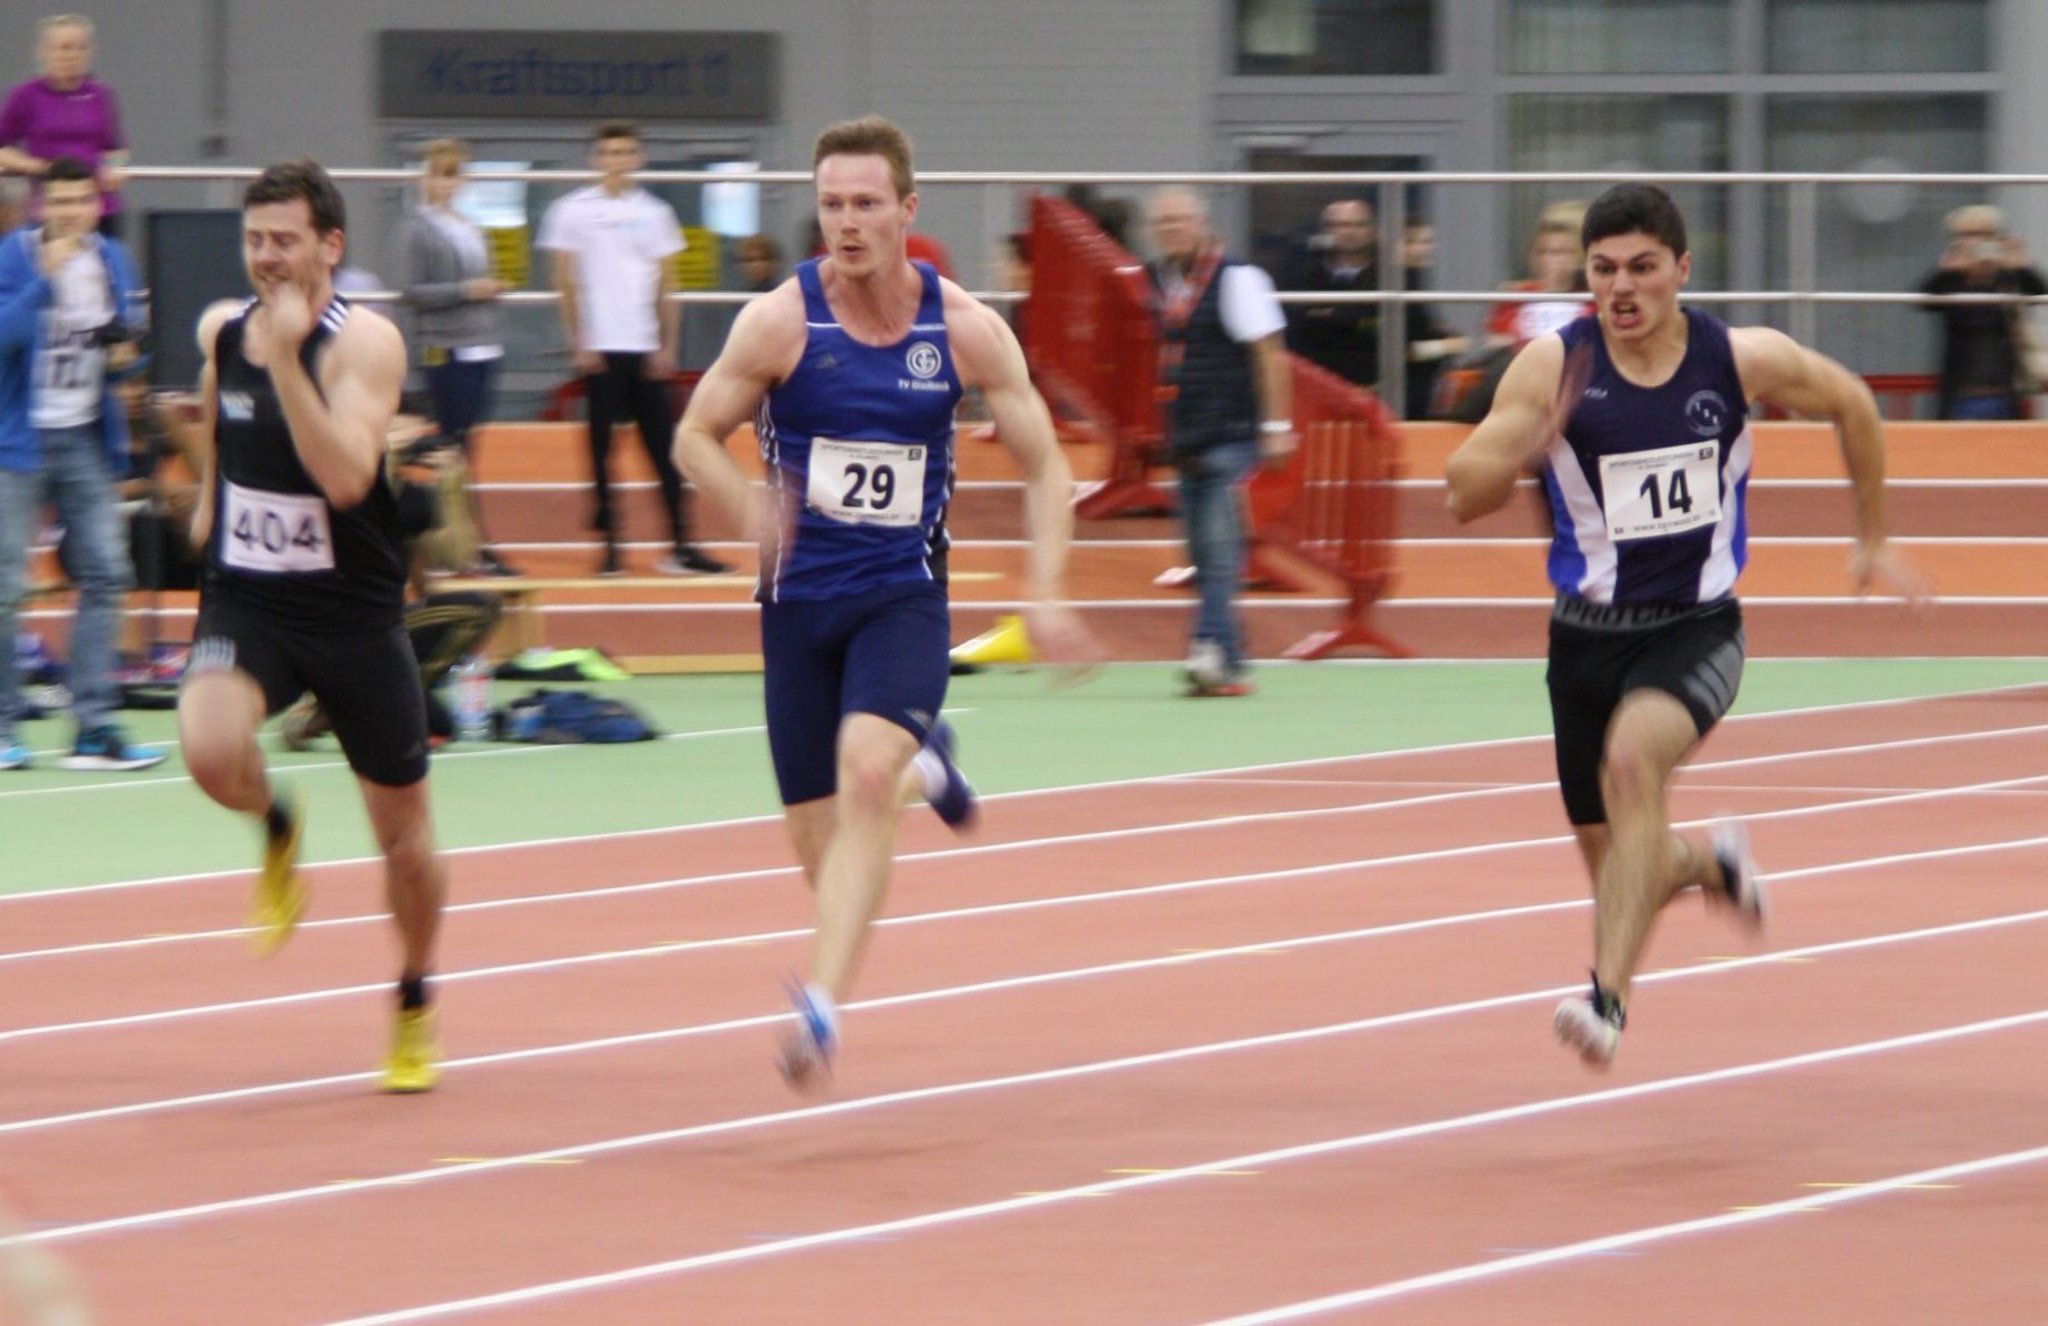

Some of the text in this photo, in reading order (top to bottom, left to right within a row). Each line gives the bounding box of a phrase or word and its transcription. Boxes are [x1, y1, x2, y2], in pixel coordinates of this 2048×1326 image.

[420, 48, 692, 105] Kraftsport
[842, 463, 895, 510] 29
[1640, 468, 1692, 519] 14
[233, 506, 324, 554] 404
